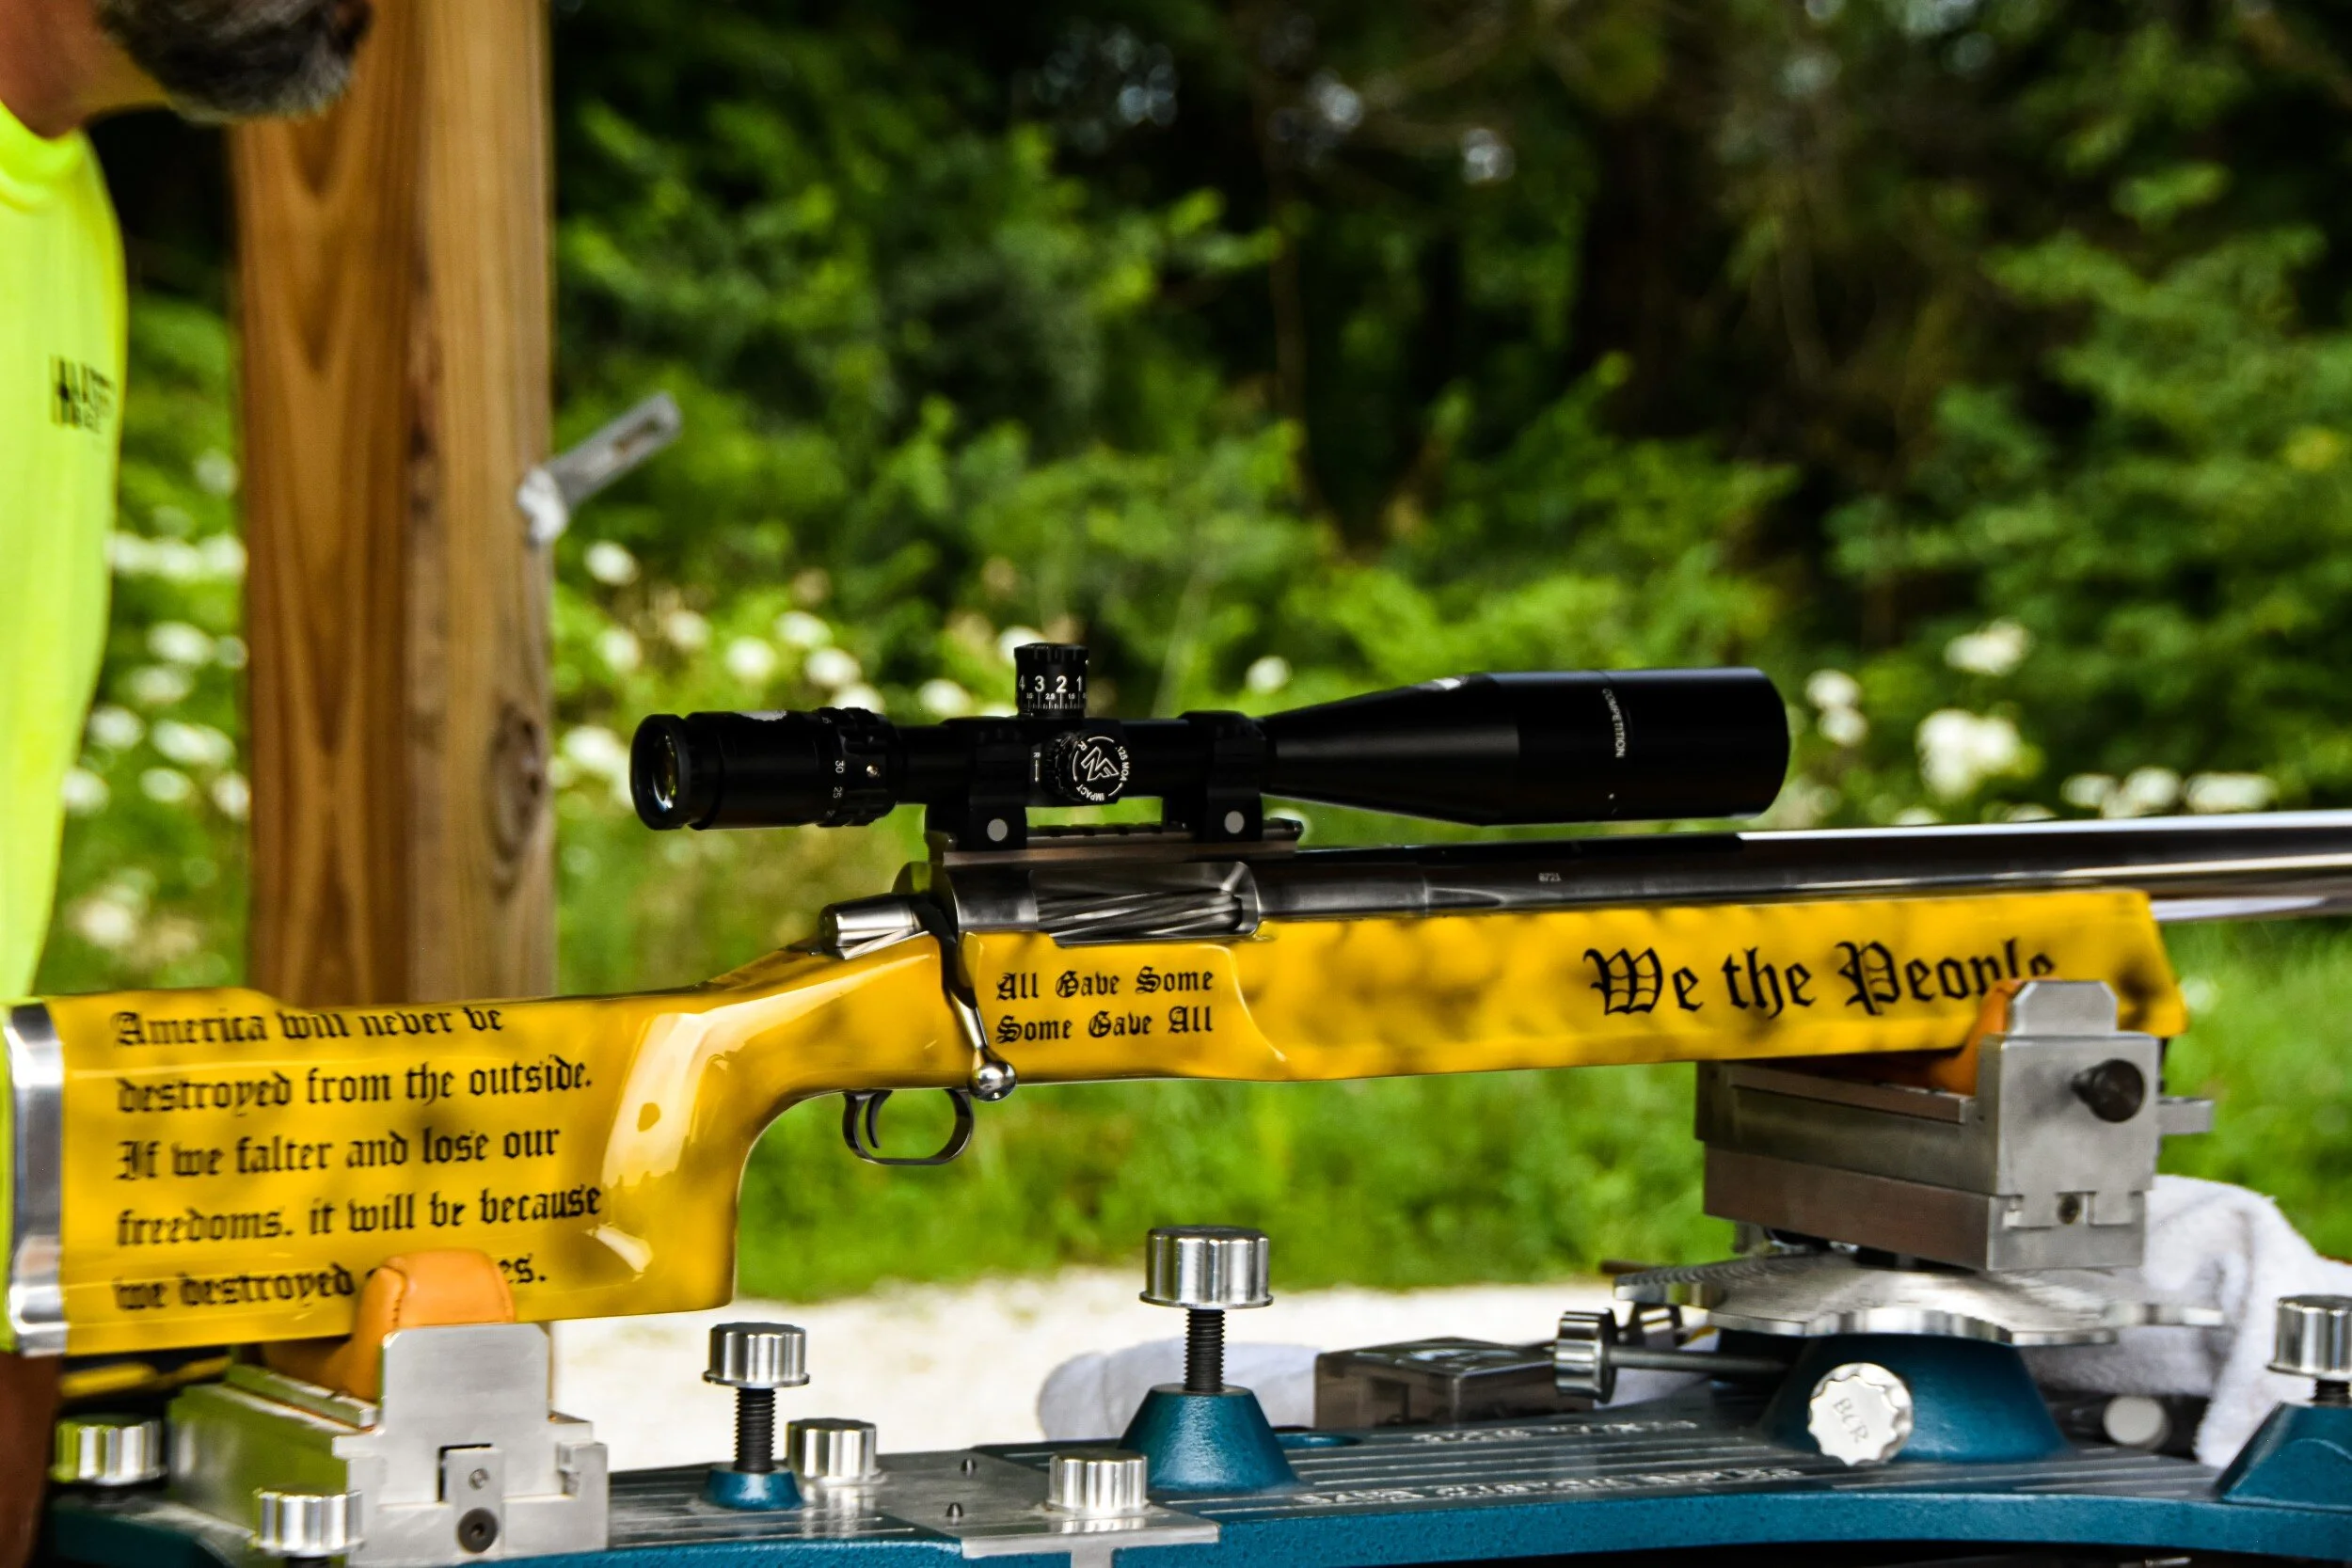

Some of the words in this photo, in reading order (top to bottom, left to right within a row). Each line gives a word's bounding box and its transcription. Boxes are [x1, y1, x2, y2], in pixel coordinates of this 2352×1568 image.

[1034, 674, 1045, 692] 3
[1056, 674, 1067, 693] 2
[1076, 675, 1083, 692] 1
[1602, 688, 1626, 758] COMPETITION
[834, 760, 844, 774] 30
[1120, 762, 1130, 781] MOA
[833, 786, 843, 799] 25
[1076, 784, 1105, 801] IMPACT
[997, 973, 1039, 1000] All
[1057, 971, 1120, 998] Gave
[1136, 966, 1213, 993] Some
[1583, 948, 1703, 1016] We
[1721, 946, 1817, 1021] the
[115, 1009, 268, 1048] America
[278, 1011, 348, 1041] will
[359, 1007, 453, 1037] never
[468, 1006, 503, 1033] be
[995, 1015, 1072, 1044] Some
[1089, 1011, 1152, 1037] Gave
[1168, 1006, 1213, 1033] All
[117, 1071, 293, 1117] destroyed
[308, 1068, 391, 1103] from
[405, 1063, 455, 1105] the
[469, 1054, 593, 1097] outside.
[115, 1139, 158, 1182] If
[171, 1145, 224, 1177] we
[236, 1136, 332, 1174] falter
[347, 1131, 407, 1167] and
[422, 1126, 488, 1164] lose
[503, 1130, 560, 1159] our
[310, 1198, 336, 1235] it
[349, 1194, 414, 1232] will
[430, 1193, 465, 1227] be
[479, 1183, 602, 1225] because
[113, 1277, 167, 1310] we
[179, 1262, 356, 1308] destroyed
